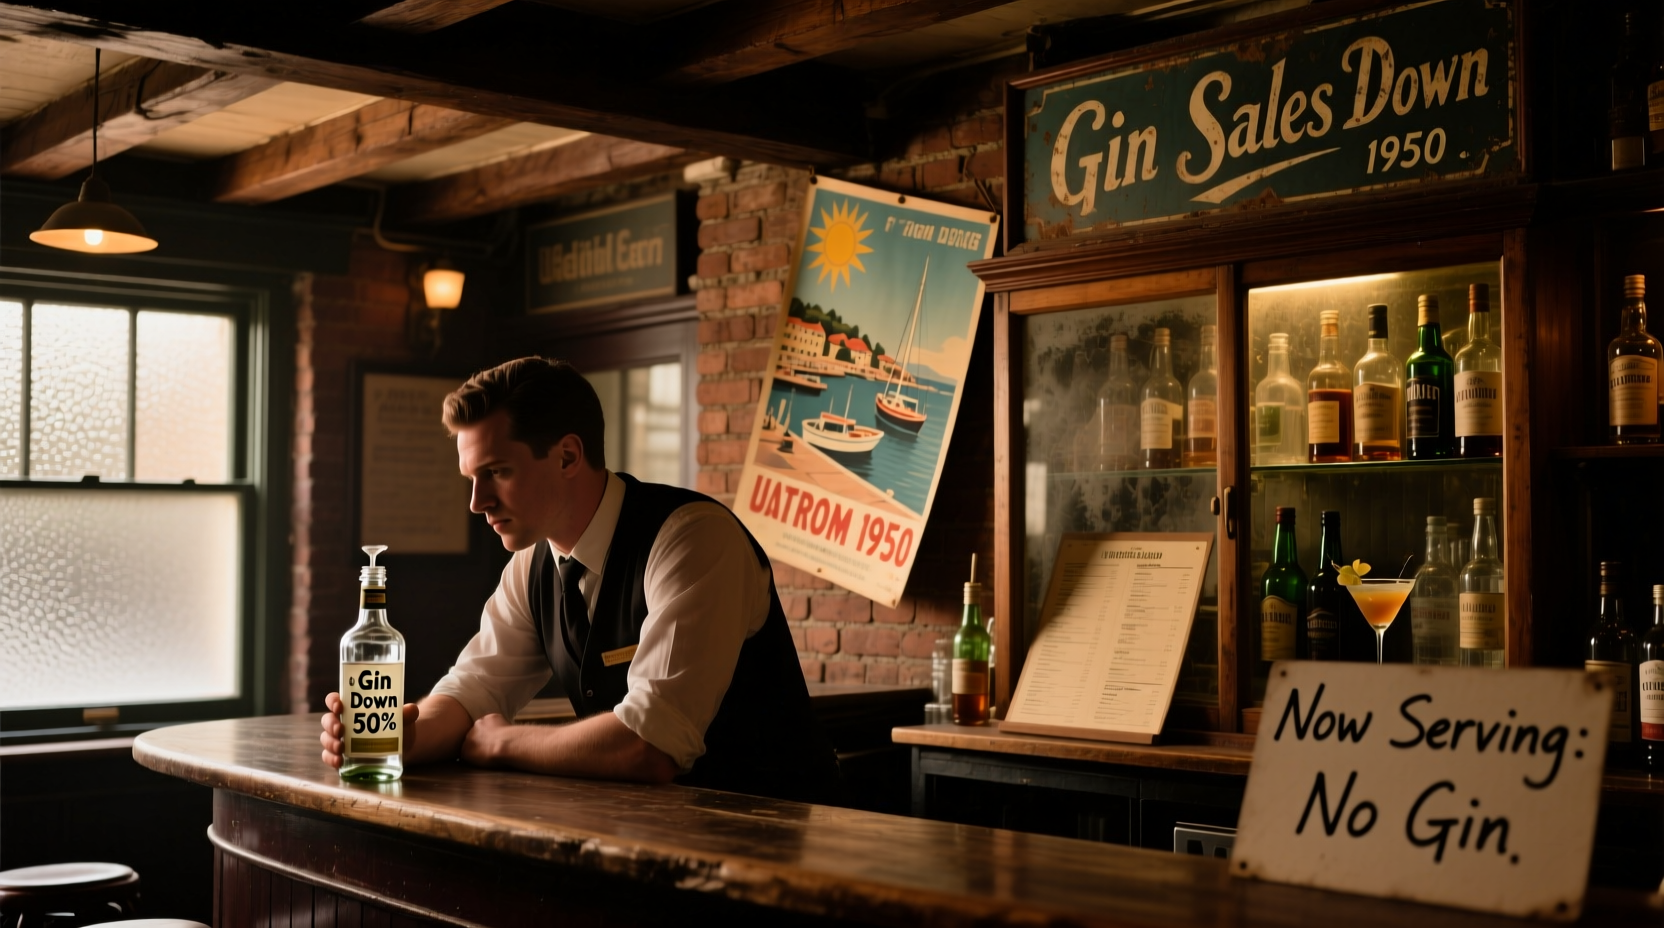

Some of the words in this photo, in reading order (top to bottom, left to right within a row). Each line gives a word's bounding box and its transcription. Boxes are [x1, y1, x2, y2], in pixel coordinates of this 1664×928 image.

[1050, 100, 1158, 217] Gin
[1175, 57, 1333, 184] Sales
[1341, 35, 1489, 130] Down
[1366, 127, 1446, 174] 1950
[749, 475, 853, 546] UATROM
[856, 513, 914, 567] 1950
[350, 692, 397, 709] Down
[358, 669, 391, 690] Gin
[353, 712, 396, 734] 50%
[1274, 683, 1372, 744] Now
[1389, 694, 1589, 790] Serving:
[1295, 770, 1378, 838] No
[1405, 780, 1524, 865] Gin.
